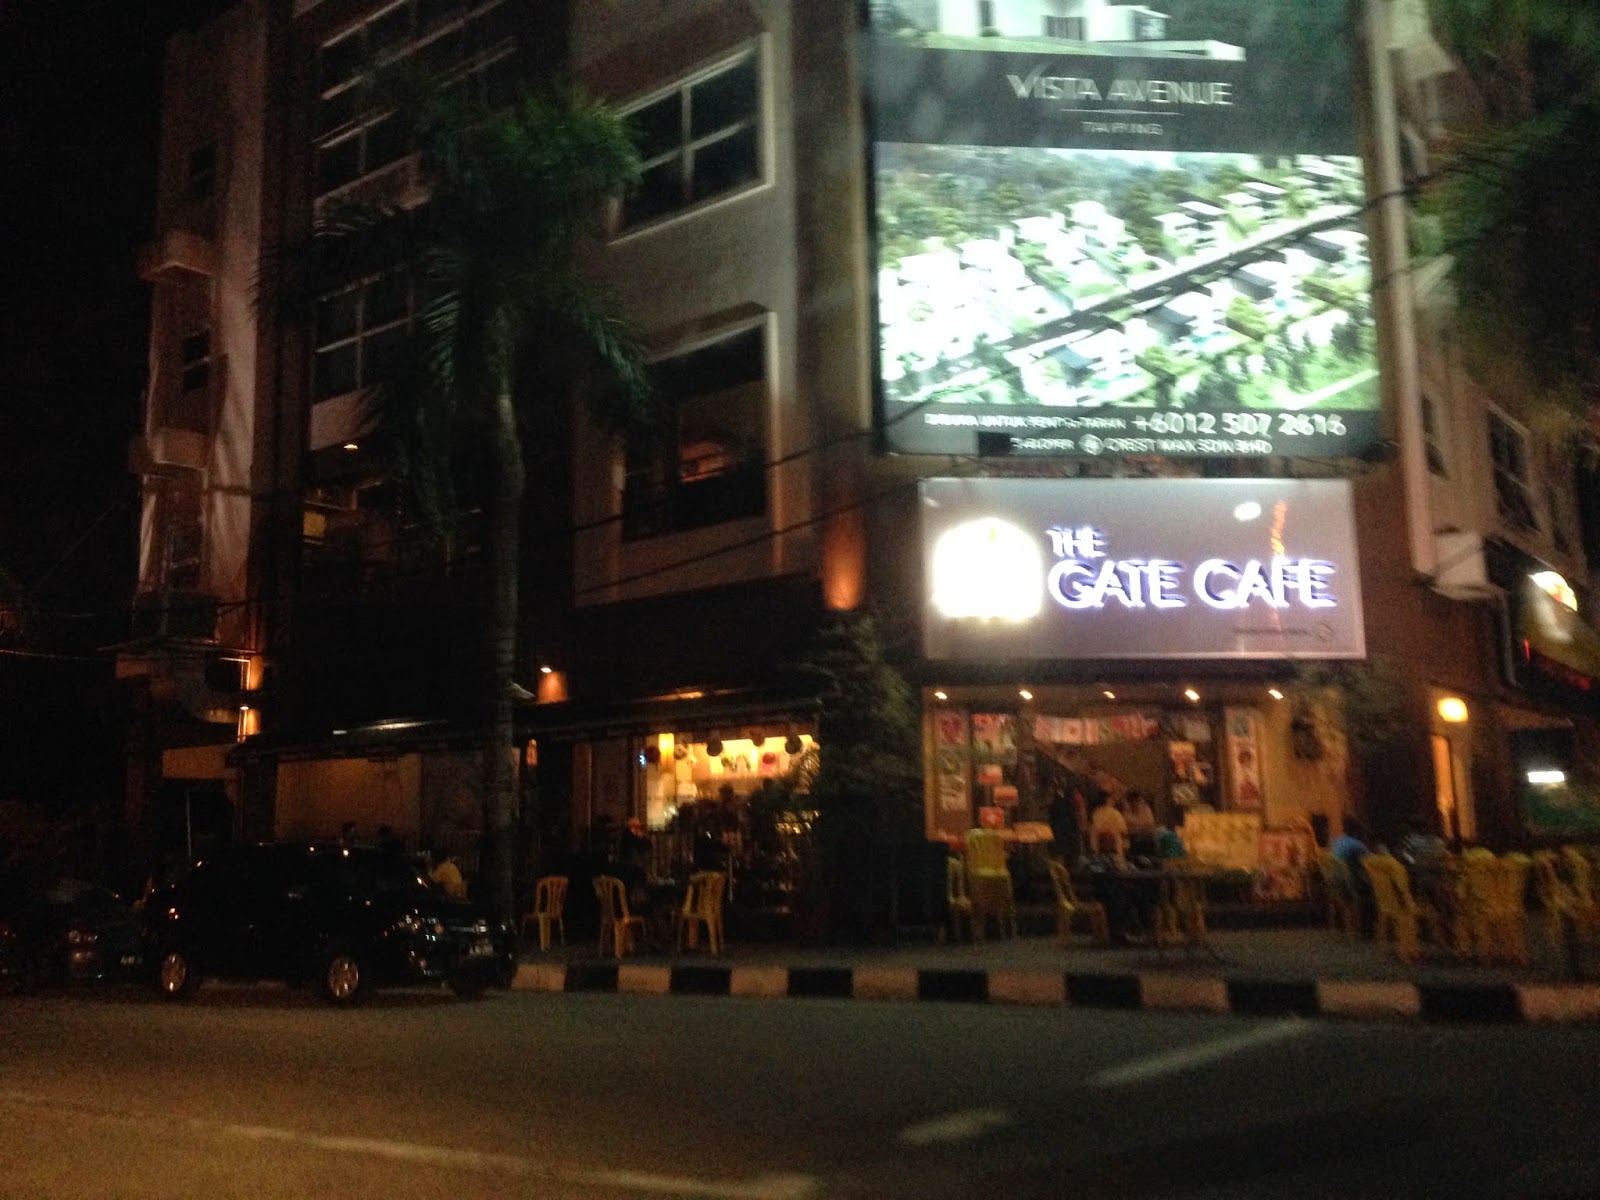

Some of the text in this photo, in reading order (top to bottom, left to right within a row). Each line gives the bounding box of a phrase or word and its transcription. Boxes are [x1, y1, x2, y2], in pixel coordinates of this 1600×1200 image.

[1006, 65, 1233, 105] VISTA AVENUE
[1131, 411, 1217, 434] +6012
[1221, 412, 1272, 437] 507
[1277, 413, 1347, 436] 2616
[1046, 527, 1107, 558] THE
[1048, 557, 1337, 609] GATE CAFE
